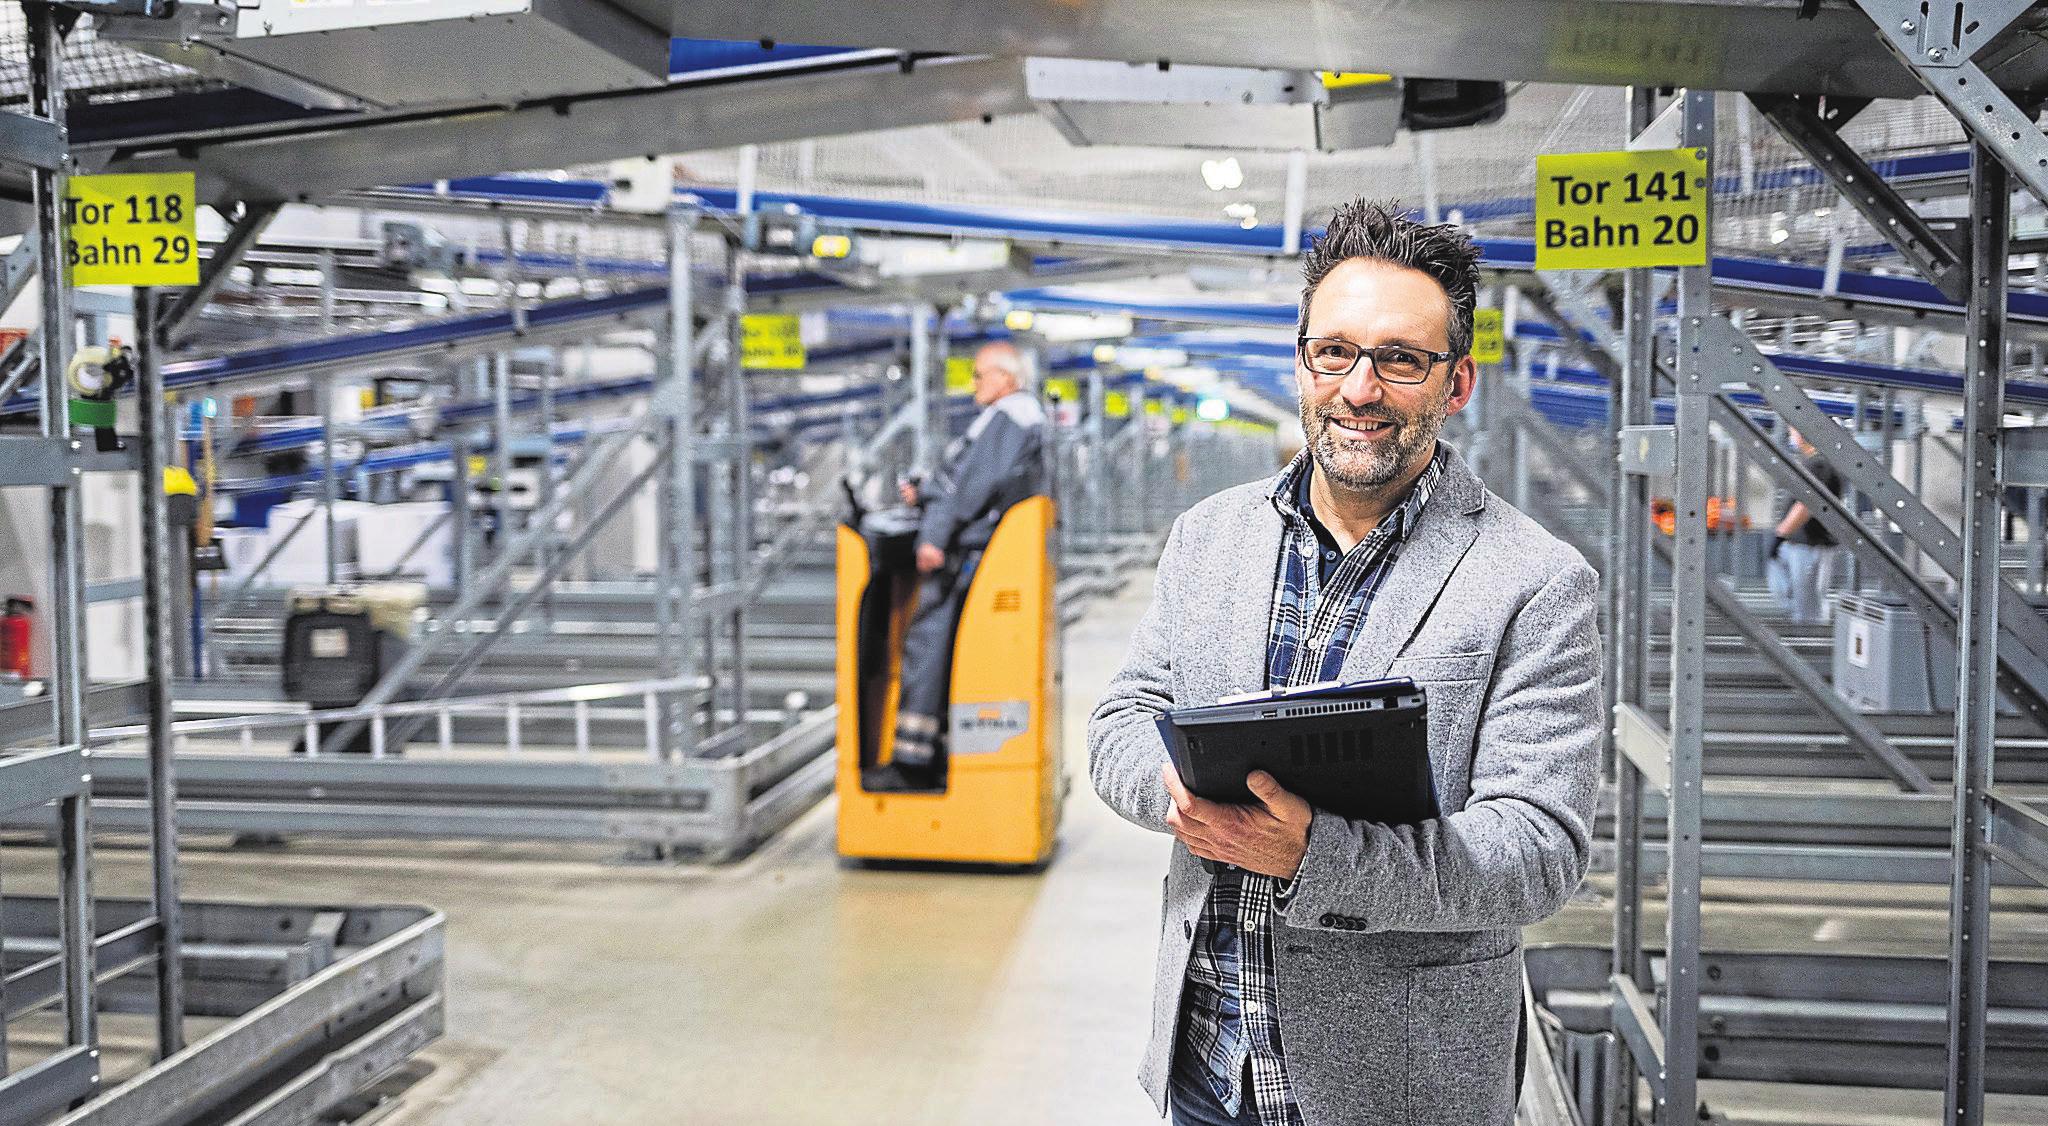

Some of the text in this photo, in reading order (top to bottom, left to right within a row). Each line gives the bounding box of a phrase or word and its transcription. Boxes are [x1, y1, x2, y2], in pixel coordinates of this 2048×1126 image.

[1551, 170, 1691, 206] Tor 141
[64, 194, 183, 224] Tor 118
[1545, 213, 1699, 249] Bahn 20
[153, 236, 190, 264] 29
